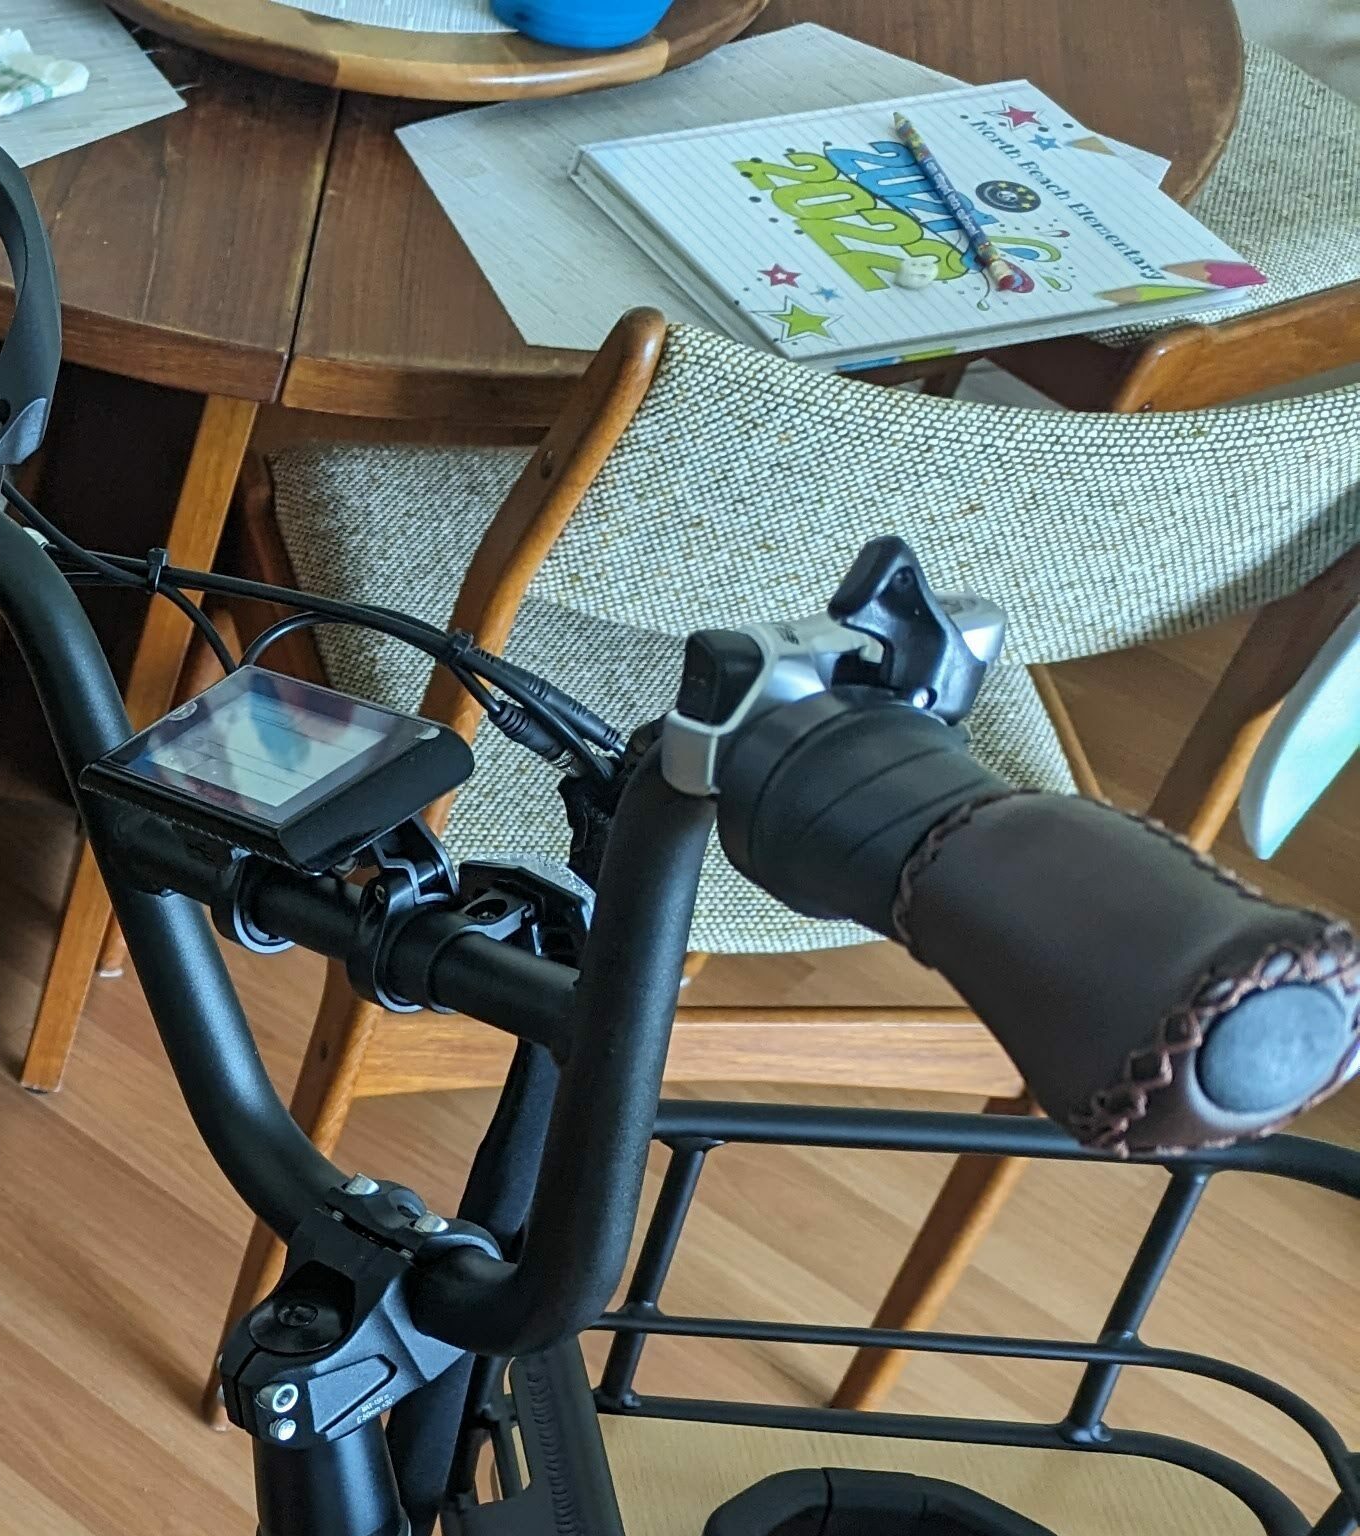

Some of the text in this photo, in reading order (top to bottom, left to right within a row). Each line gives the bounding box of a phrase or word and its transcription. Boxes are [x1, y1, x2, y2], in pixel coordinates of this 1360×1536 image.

[731, 151, 970, 293] 2022
[970, 120, 1023, 161] North
[1068, 201, 1168, 281] Elementary
